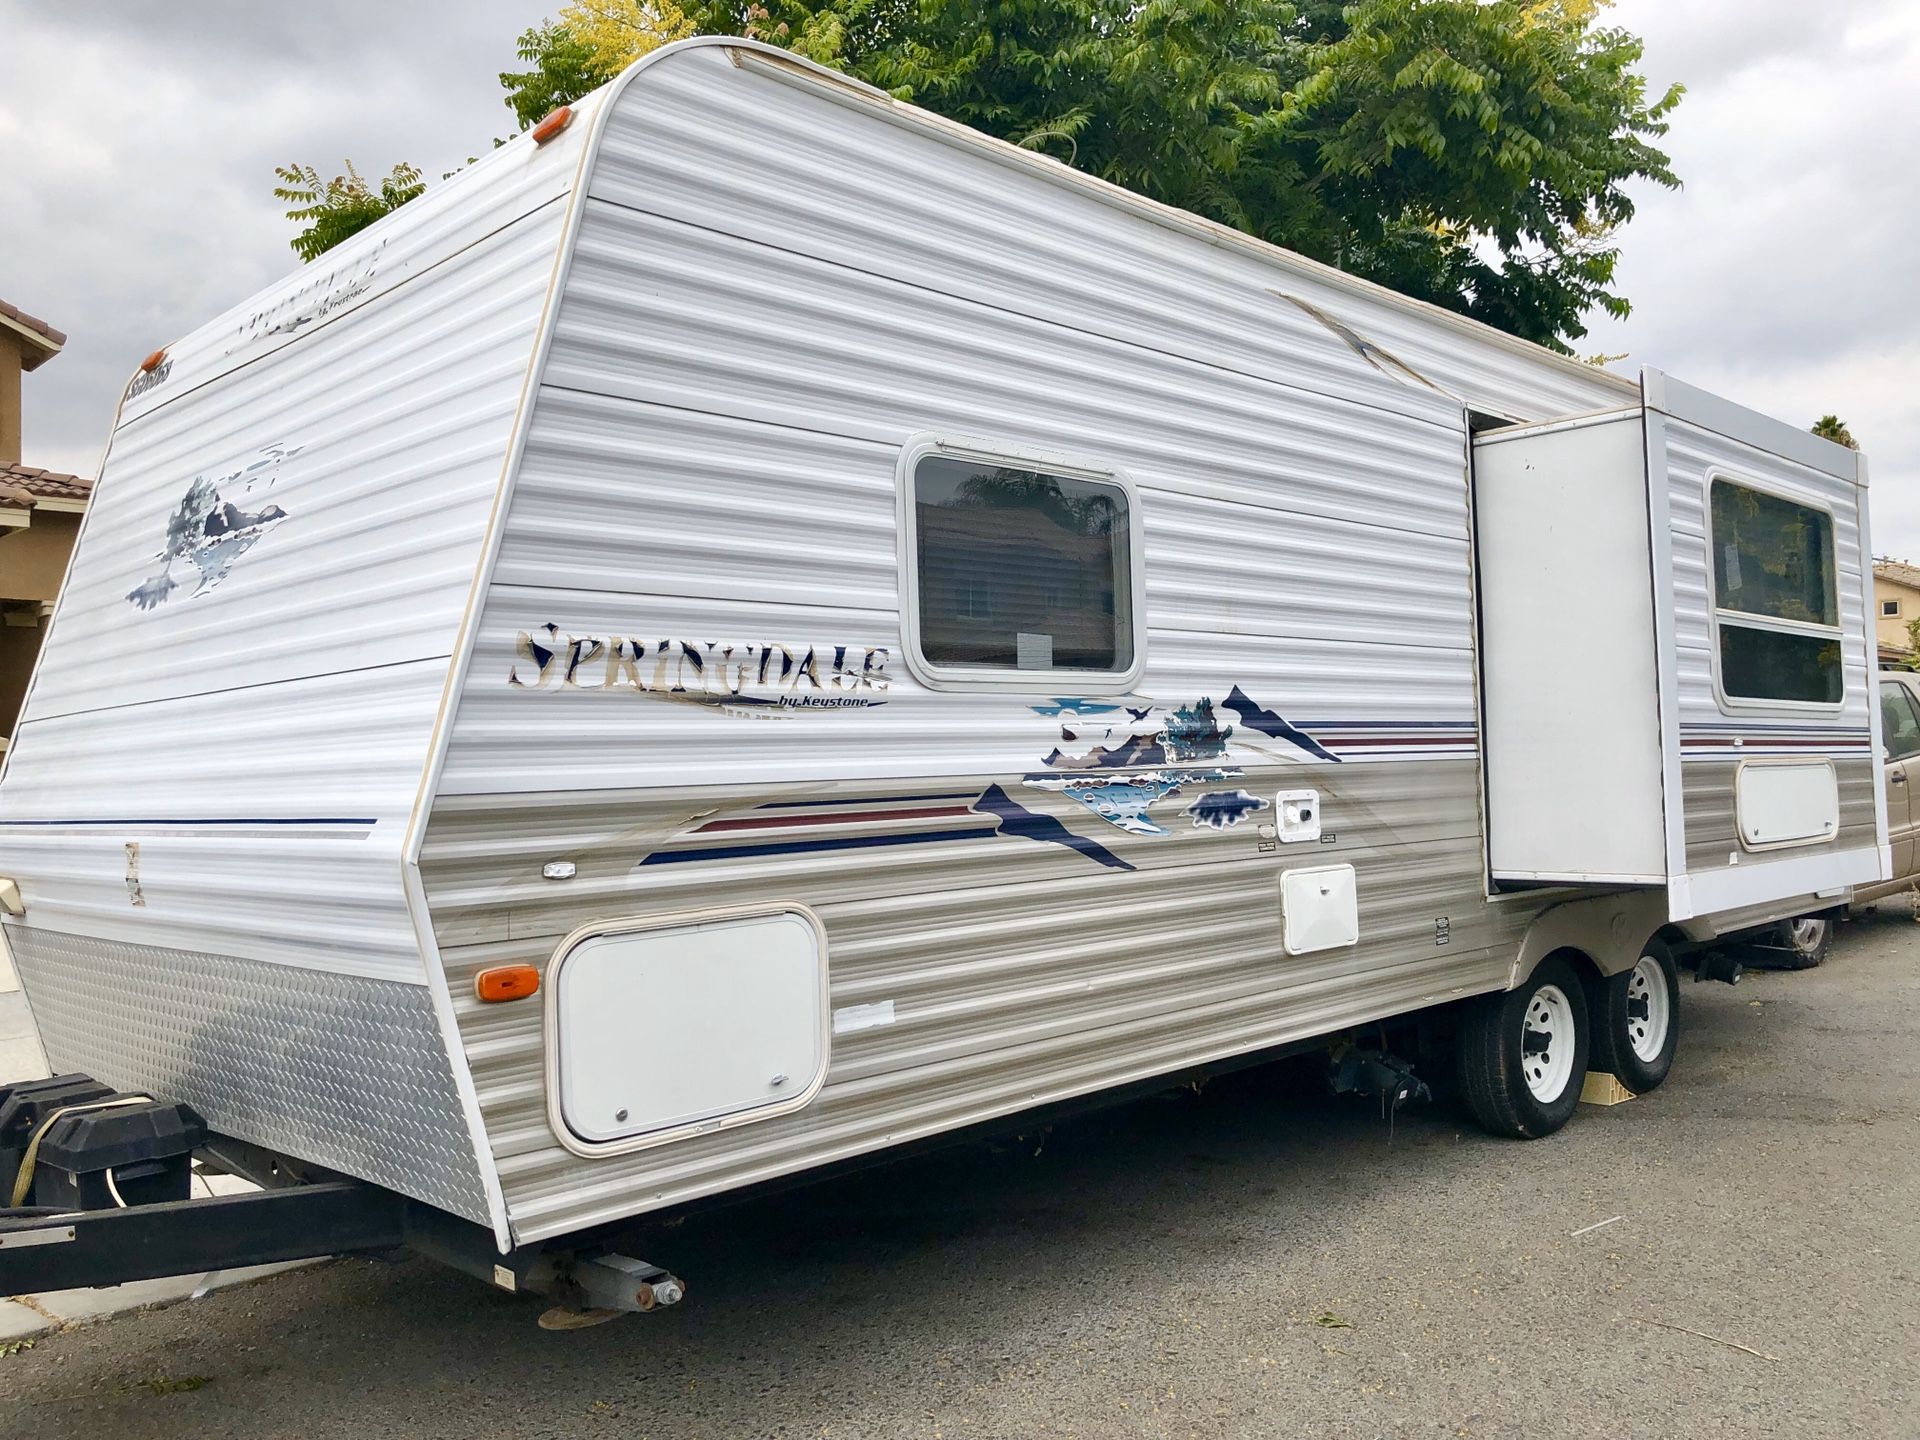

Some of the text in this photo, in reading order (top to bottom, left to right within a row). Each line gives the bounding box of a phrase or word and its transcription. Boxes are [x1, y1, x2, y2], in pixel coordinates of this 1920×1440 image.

[509, 622, 889, 694] SPRINGDALE
[777, 695, 869, 707] by Keystone
